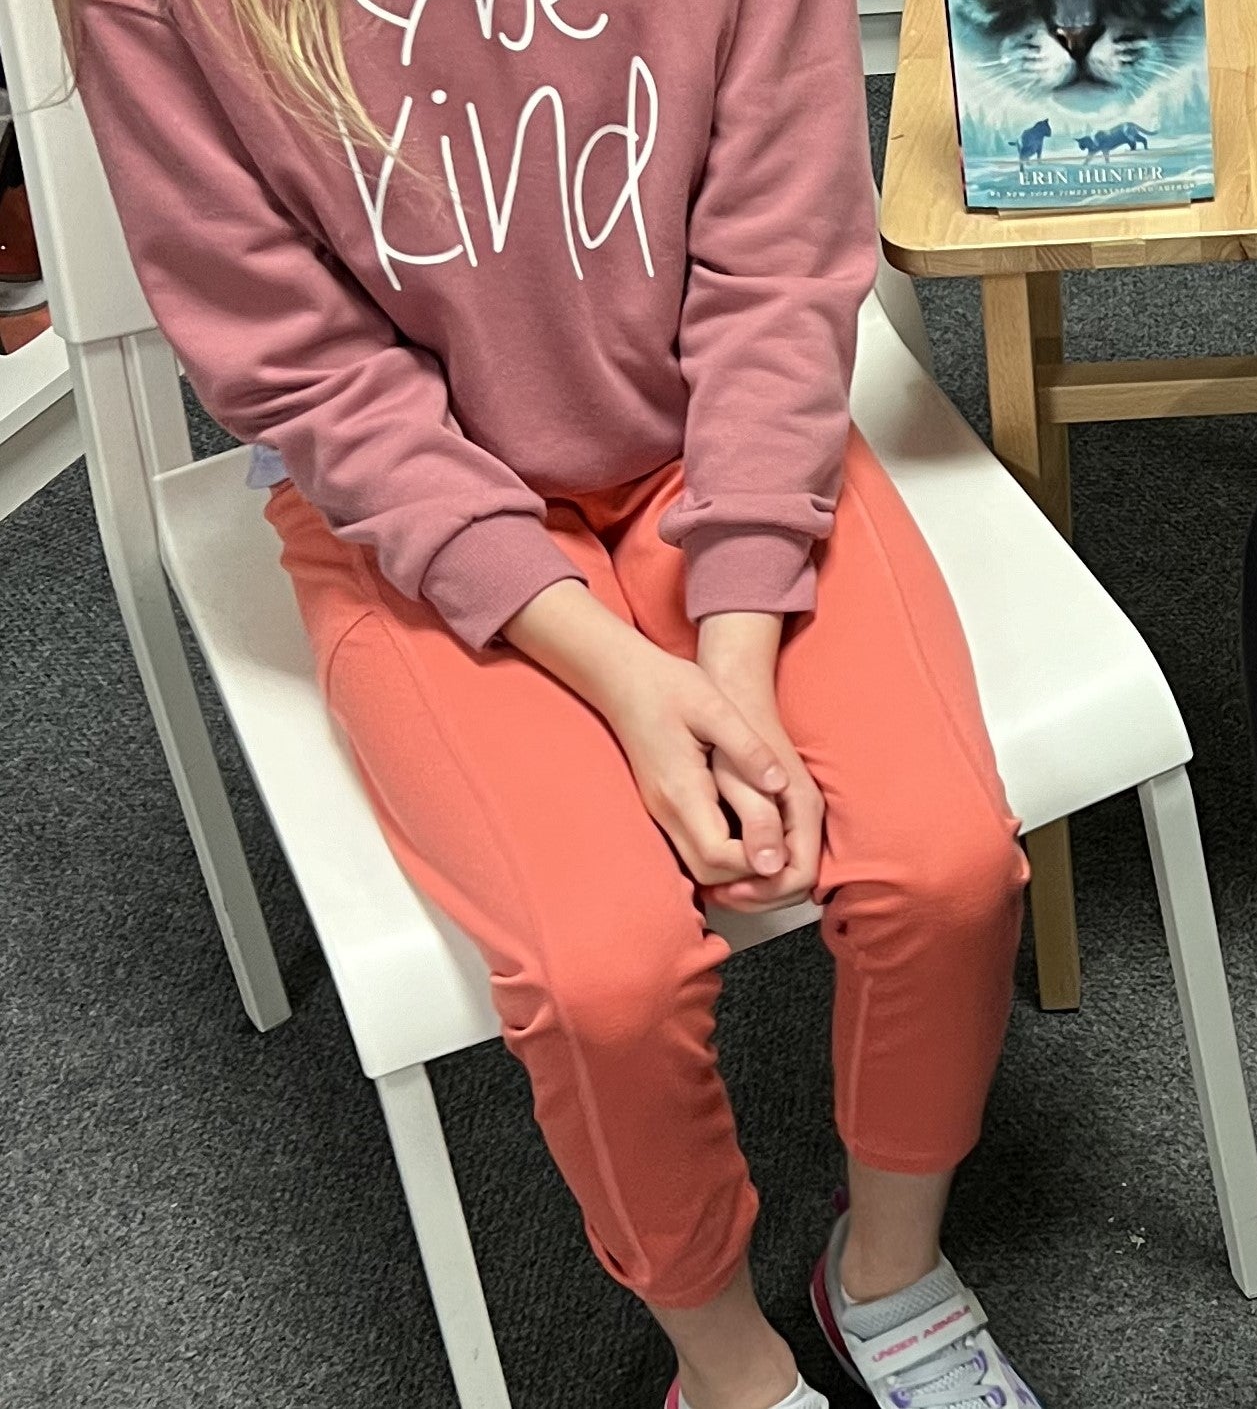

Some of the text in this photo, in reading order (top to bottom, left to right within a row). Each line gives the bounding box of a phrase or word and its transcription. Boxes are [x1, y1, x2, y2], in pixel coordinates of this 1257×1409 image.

[333, 55, 659, 292] kind
[1018, 166, 1164, 186] ERIN HUNTER
[872, 1335, 919, 1363] UNDER
